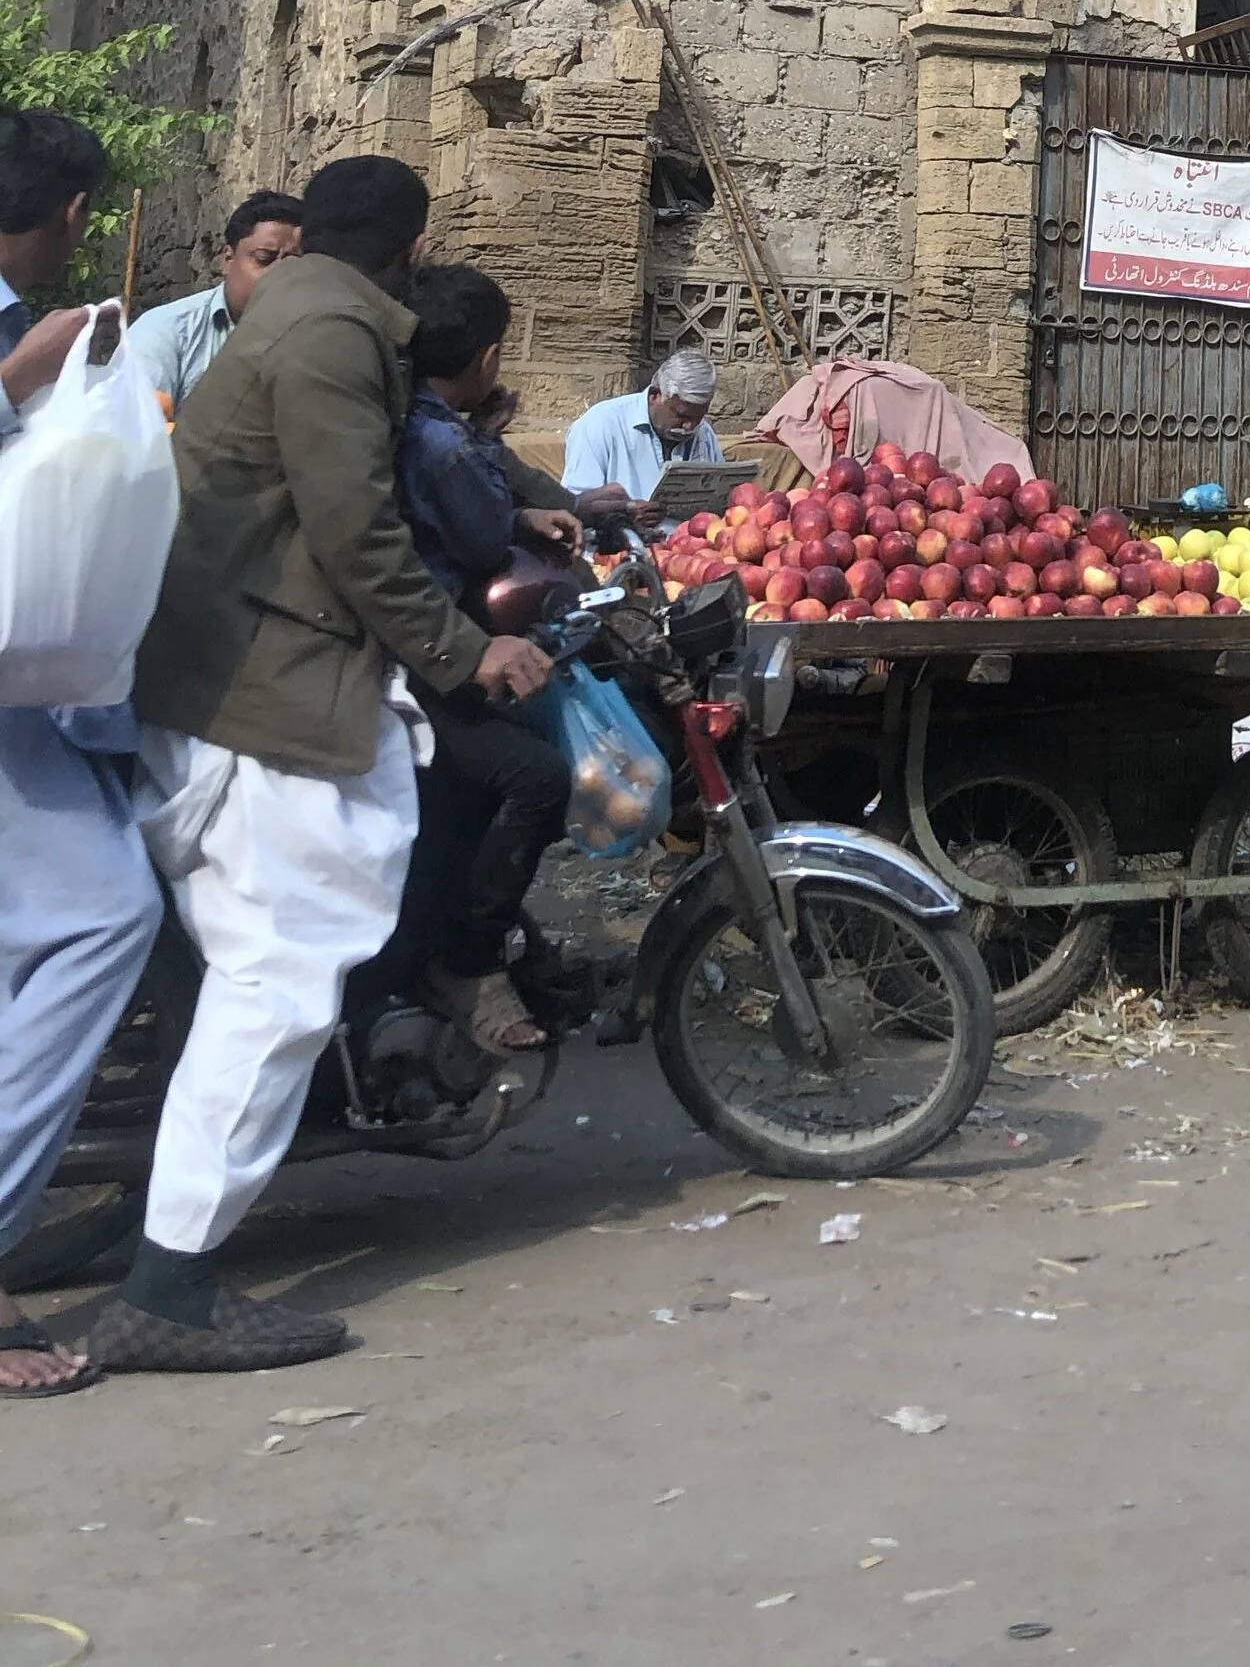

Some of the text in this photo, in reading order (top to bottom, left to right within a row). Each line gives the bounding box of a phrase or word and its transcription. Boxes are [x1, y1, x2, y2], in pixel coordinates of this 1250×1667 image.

[1173, 159, 1220, 189] انتباہ
[1156, 190, 1187, 212] مخدوش
[1186, 198, 1201, 214] نے
[1202, 201, 1242, 220] SBCA
[1105, 257, 1144, 282] اتھارٹی
[1144, 266, 1189, 288] کنٹرول
[1182, 270, 1217, 291] بلڈنگ
[1217, 281, 1249, 292] سندھ
